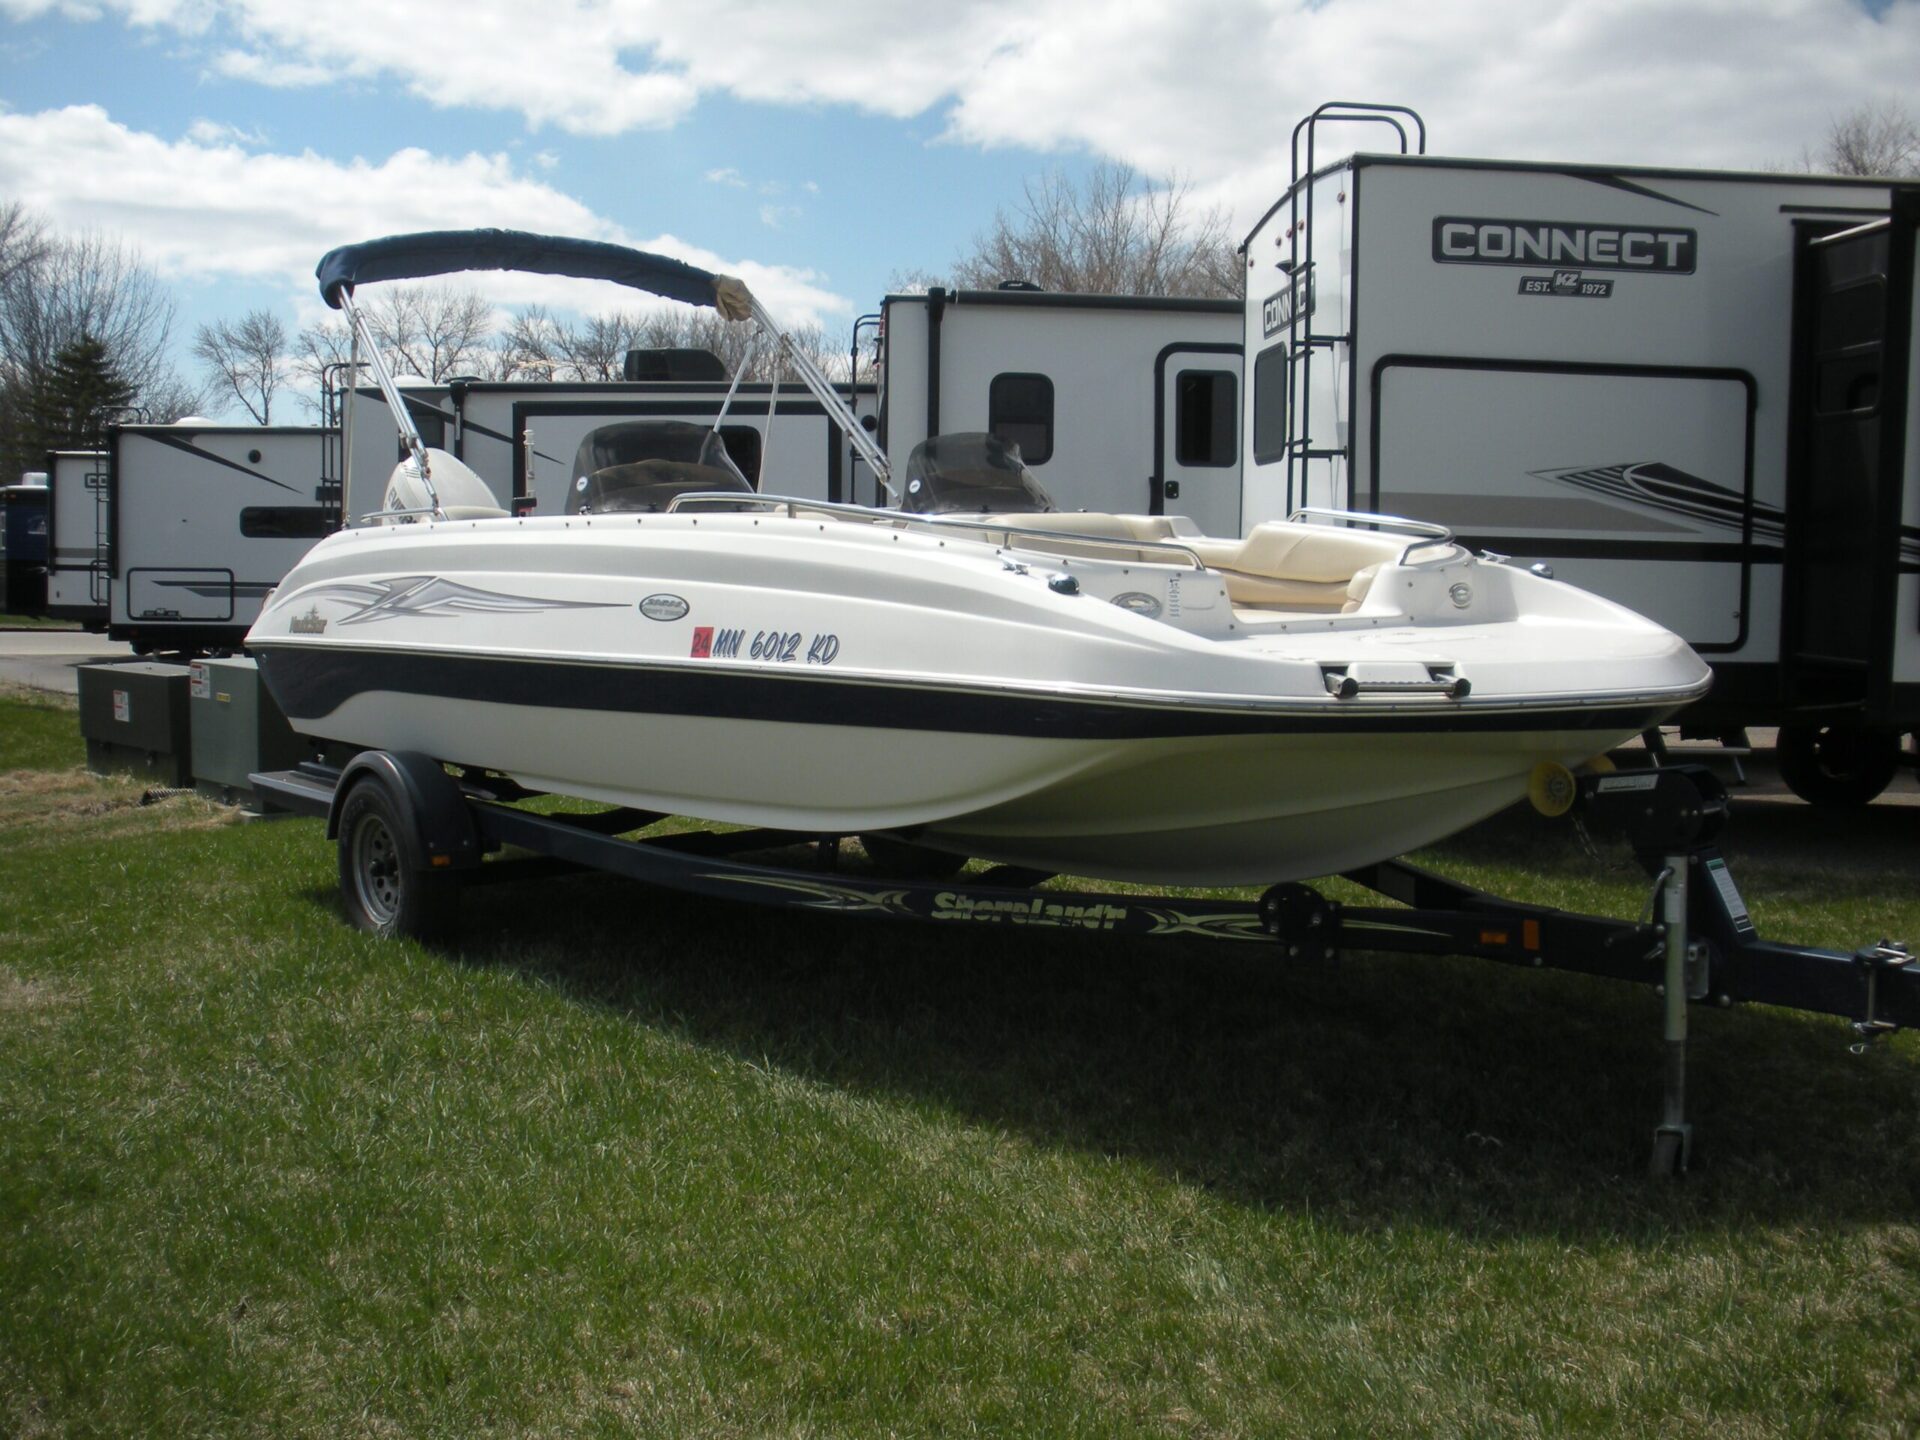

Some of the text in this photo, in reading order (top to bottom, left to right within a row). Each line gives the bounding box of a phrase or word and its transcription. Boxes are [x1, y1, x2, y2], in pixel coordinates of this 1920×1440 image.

[1441, 222, 1689, 268] CONNECT
[1525, 272, 1607, 295] EST. KZ 1972
[692, 628, 841, 666] 24 MN 6012 KD
